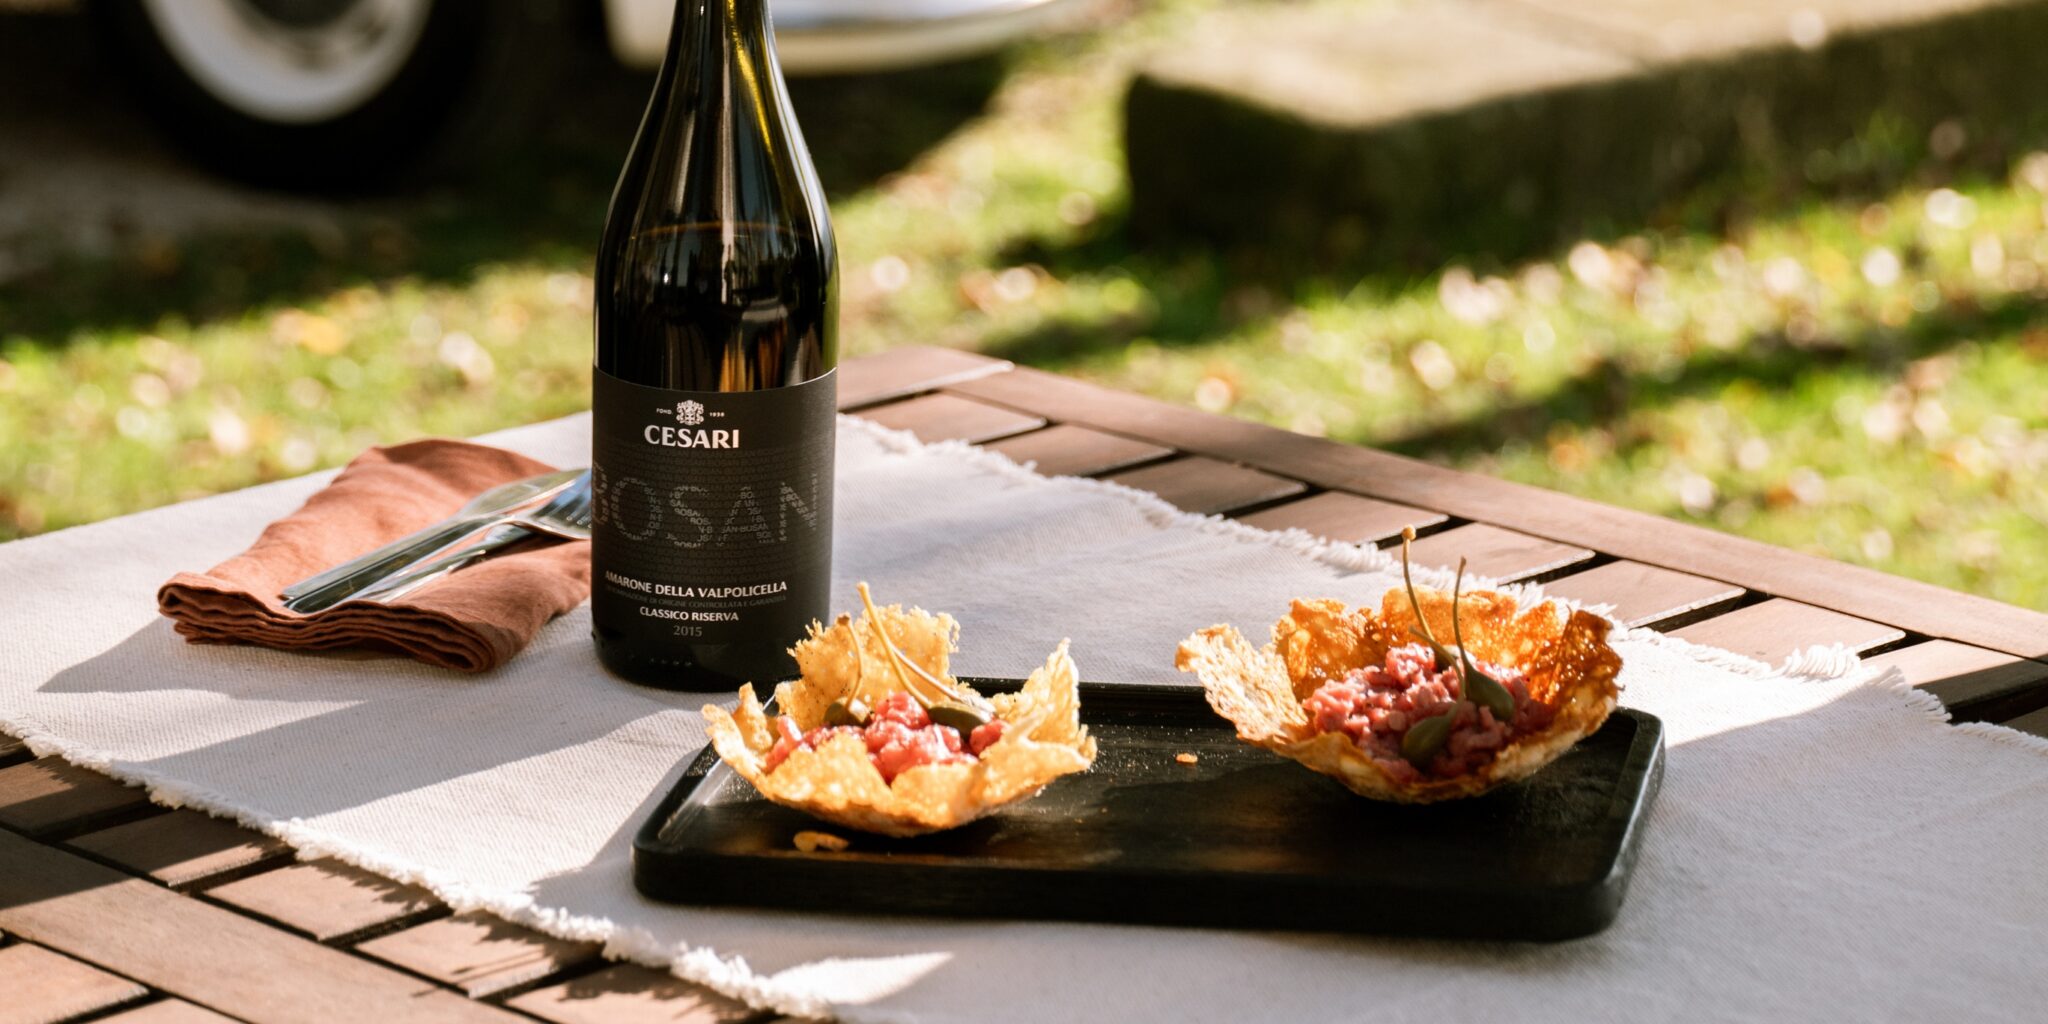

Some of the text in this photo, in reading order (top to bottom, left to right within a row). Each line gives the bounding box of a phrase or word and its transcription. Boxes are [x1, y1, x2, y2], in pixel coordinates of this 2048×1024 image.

[644, 425, 740, 449] CESARI
[605, 570, 788, 598] AMARONE DELLA VALPOLICELLA
[640, 606, 740, 621] CLASSICO RISERVA
[673, 625, 702, 637] 2015
